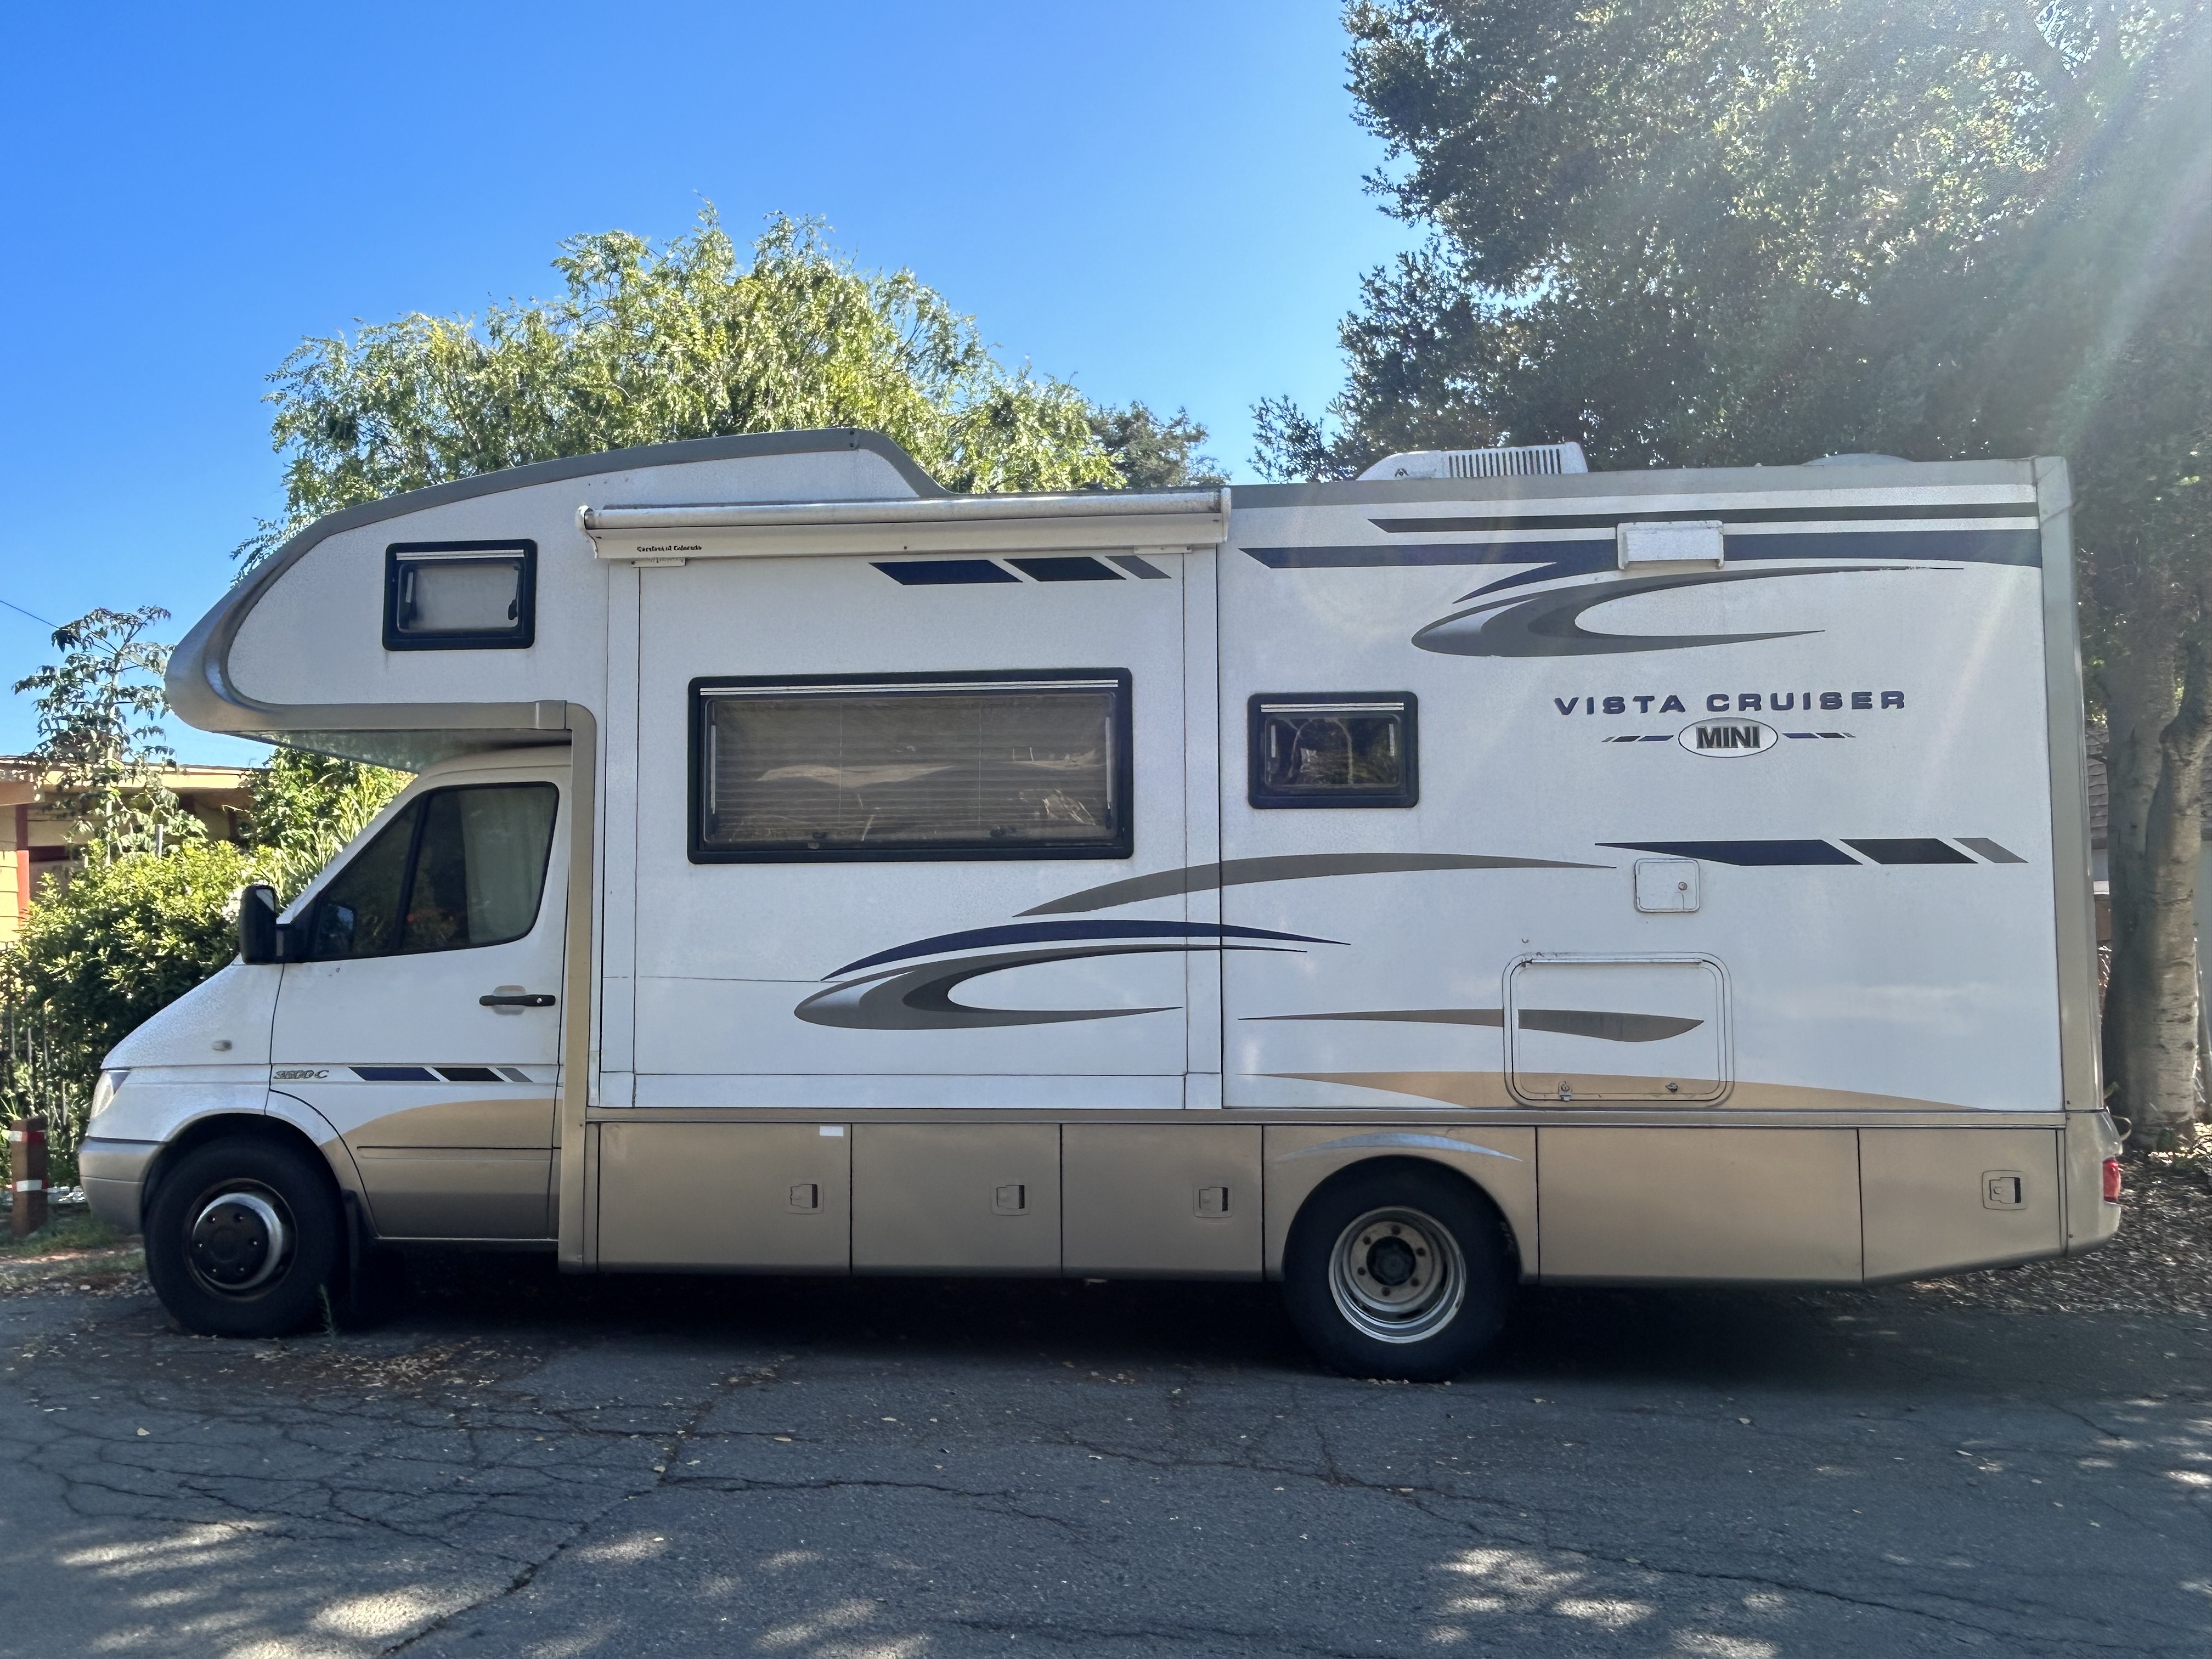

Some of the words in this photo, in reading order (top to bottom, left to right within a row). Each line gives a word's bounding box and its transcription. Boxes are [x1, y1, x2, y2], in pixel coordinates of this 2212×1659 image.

[1554, 694, 1686, 715] VISTA
[1706, 691, 1906, 712] CRUISER
[1696, 726, 1761, 749] MINI
